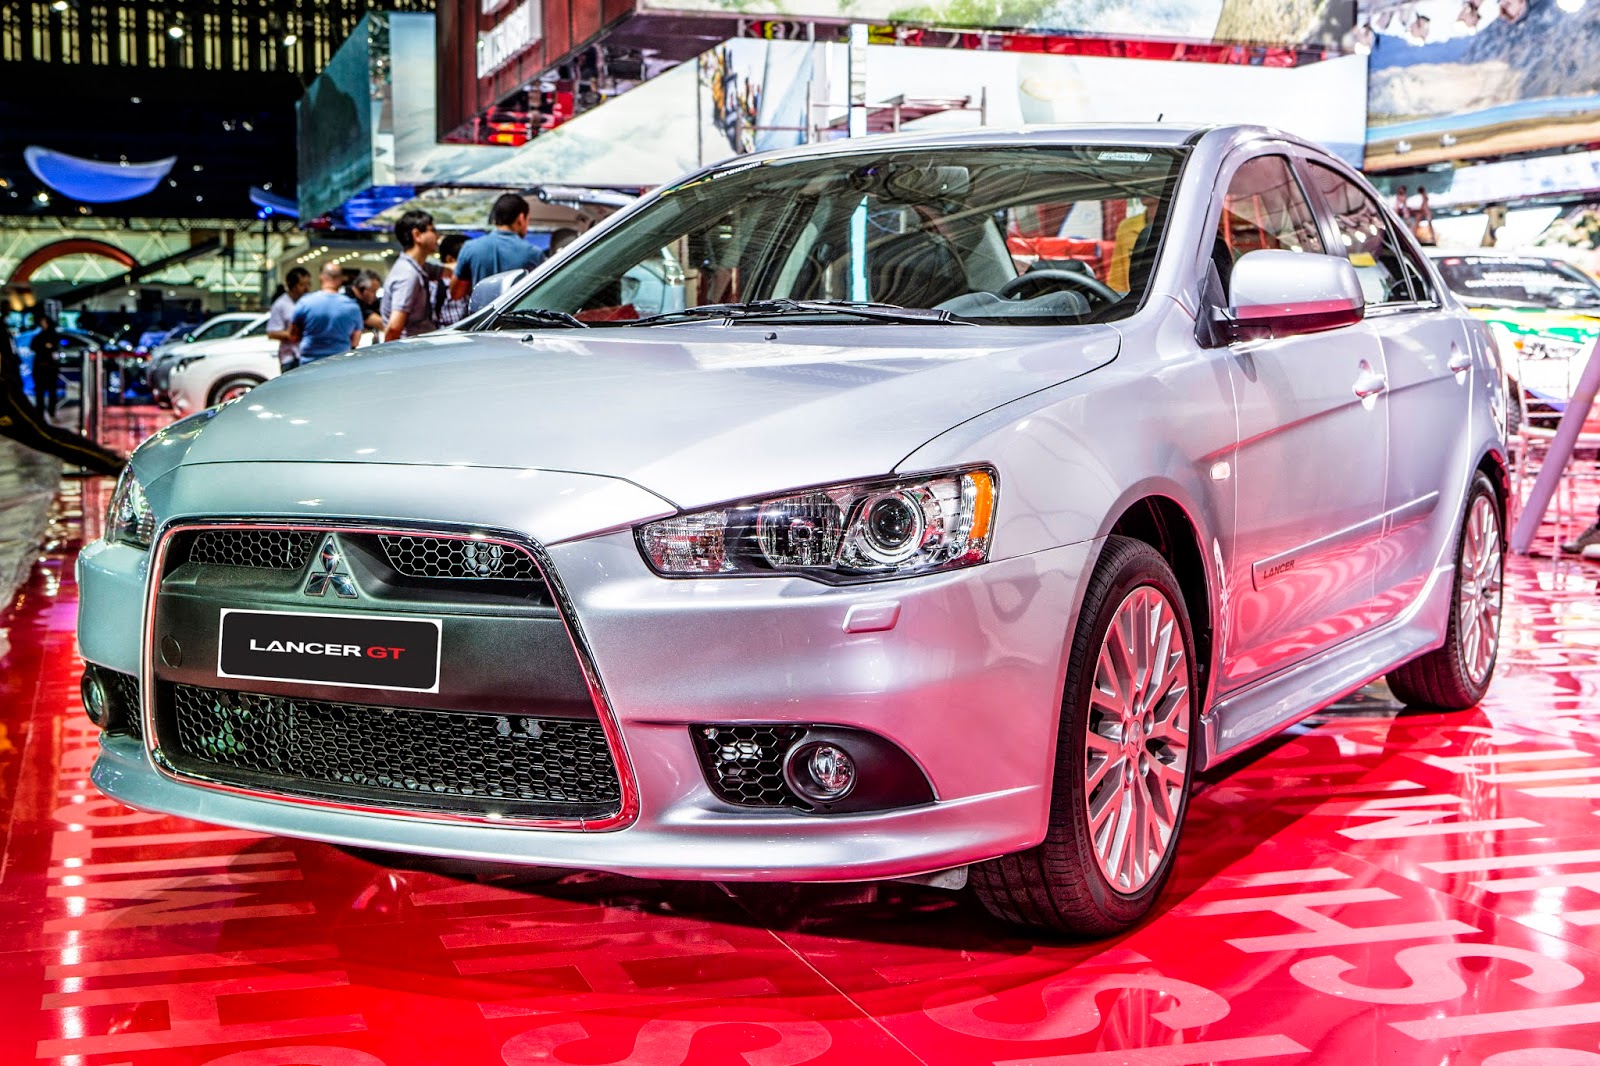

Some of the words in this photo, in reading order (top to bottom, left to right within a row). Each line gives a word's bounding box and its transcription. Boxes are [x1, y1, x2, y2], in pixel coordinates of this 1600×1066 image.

[1263, 559, 1295, 580] LANCER
[250, 638, 362, 657] LANCER
[366, 646, 405, 660] GT
